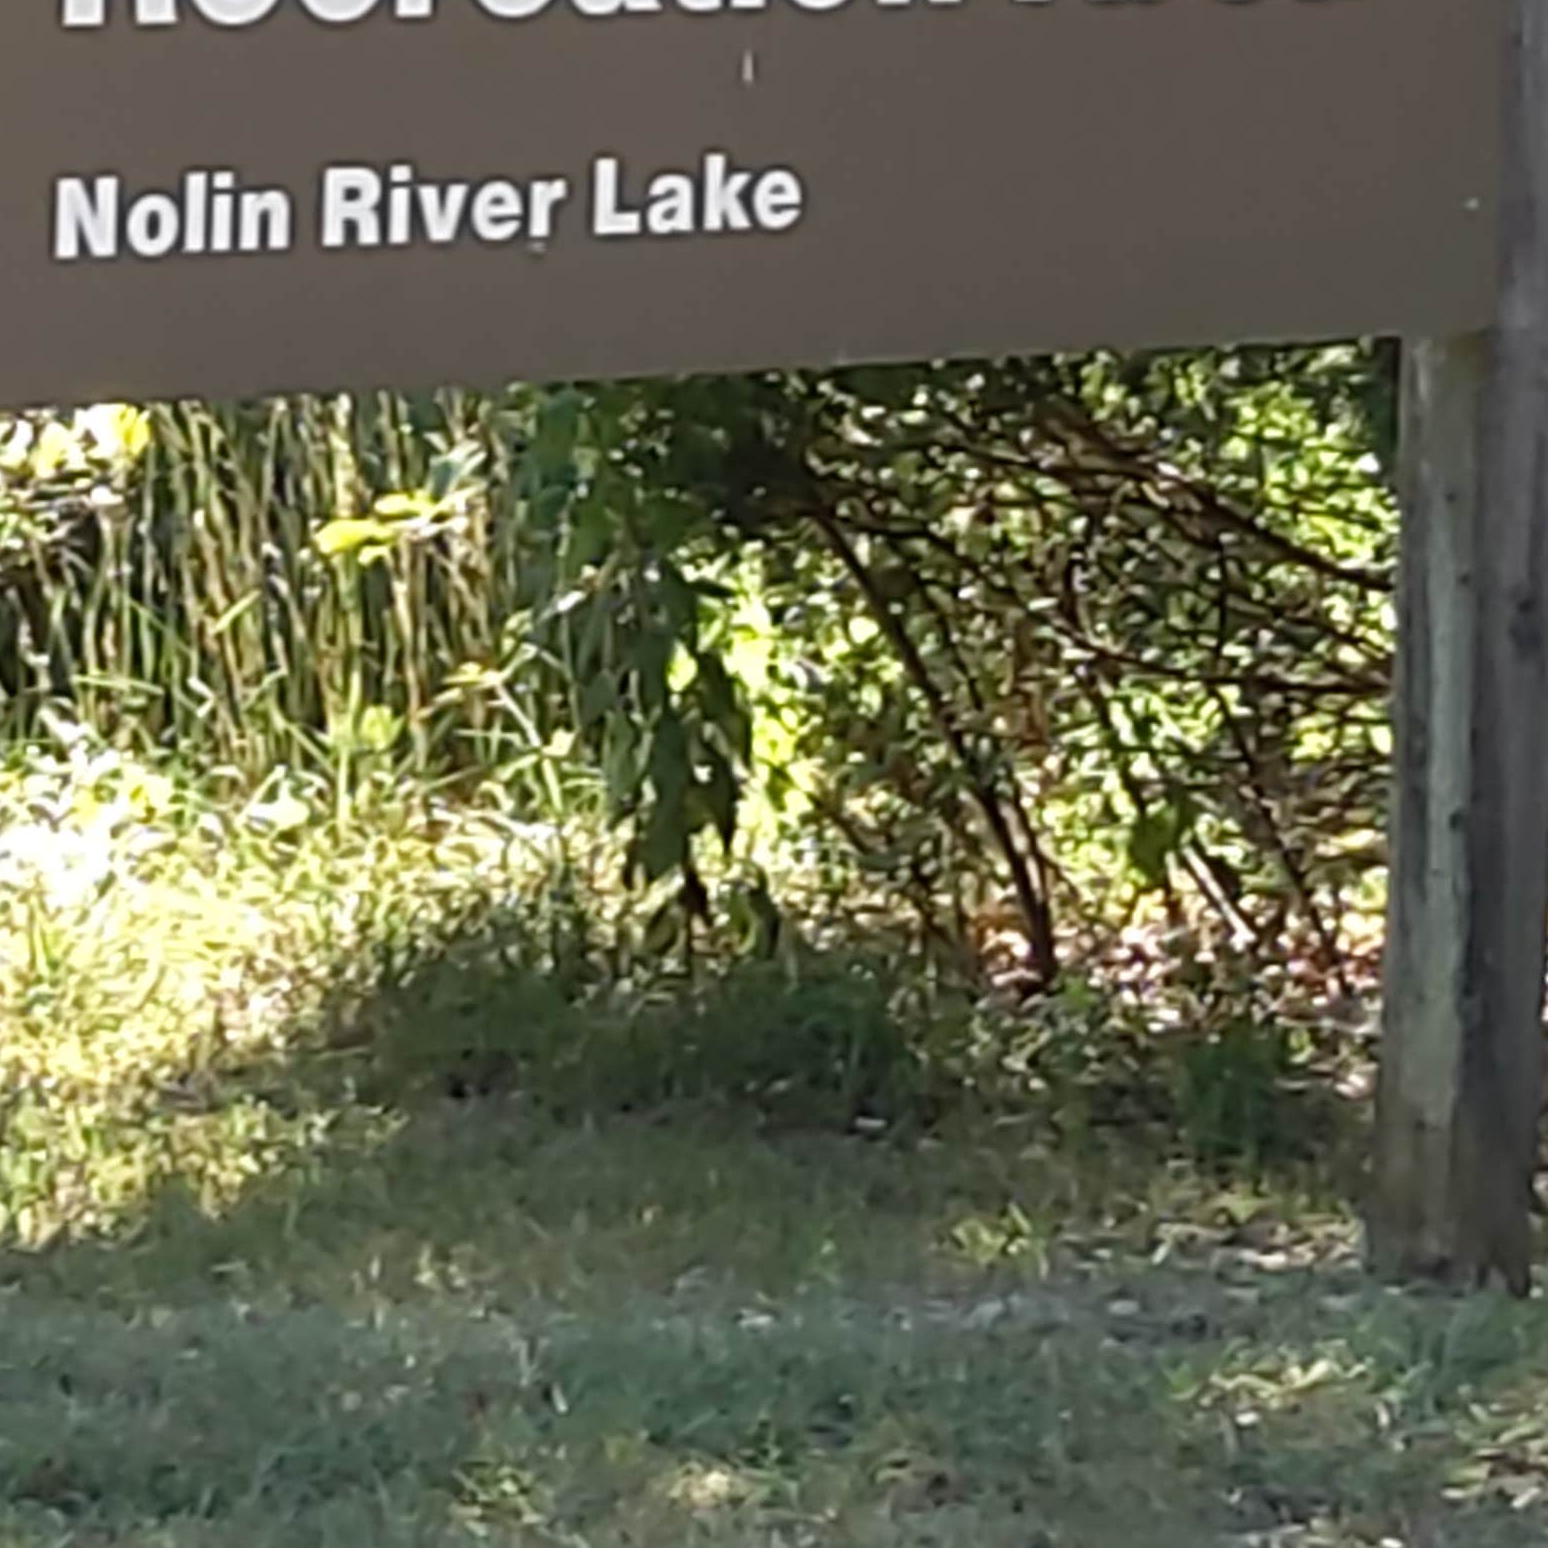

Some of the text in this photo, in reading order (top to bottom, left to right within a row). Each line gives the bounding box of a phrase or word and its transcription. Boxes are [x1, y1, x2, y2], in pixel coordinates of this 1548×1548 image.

[54, 153, 802, 259] Nolin River Lake
